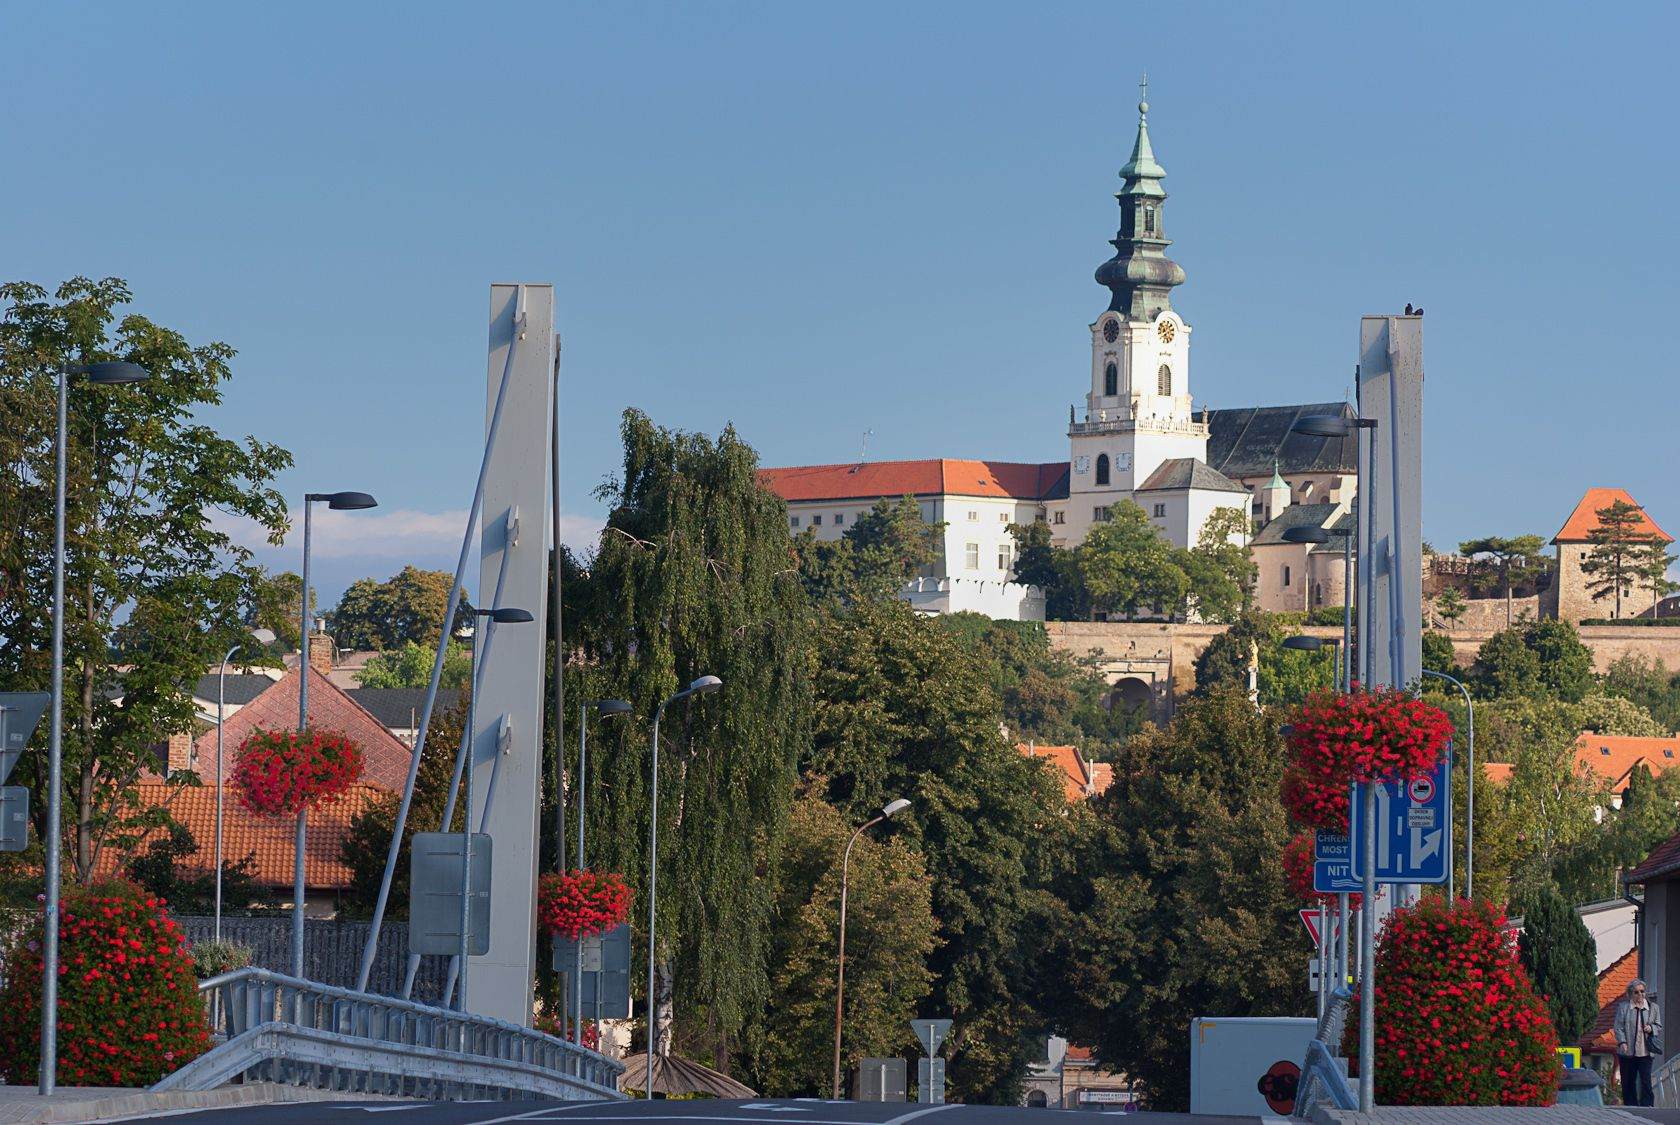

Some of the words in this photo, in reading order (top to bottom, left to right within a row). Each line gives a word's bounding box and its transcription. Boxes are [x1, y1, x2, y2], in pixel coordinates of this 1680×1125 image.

[1317, 834, 1350, 843] CHREN
[1322, 845, 1349, 854] MOST
[1327, 865, 1349, 877] NIT
